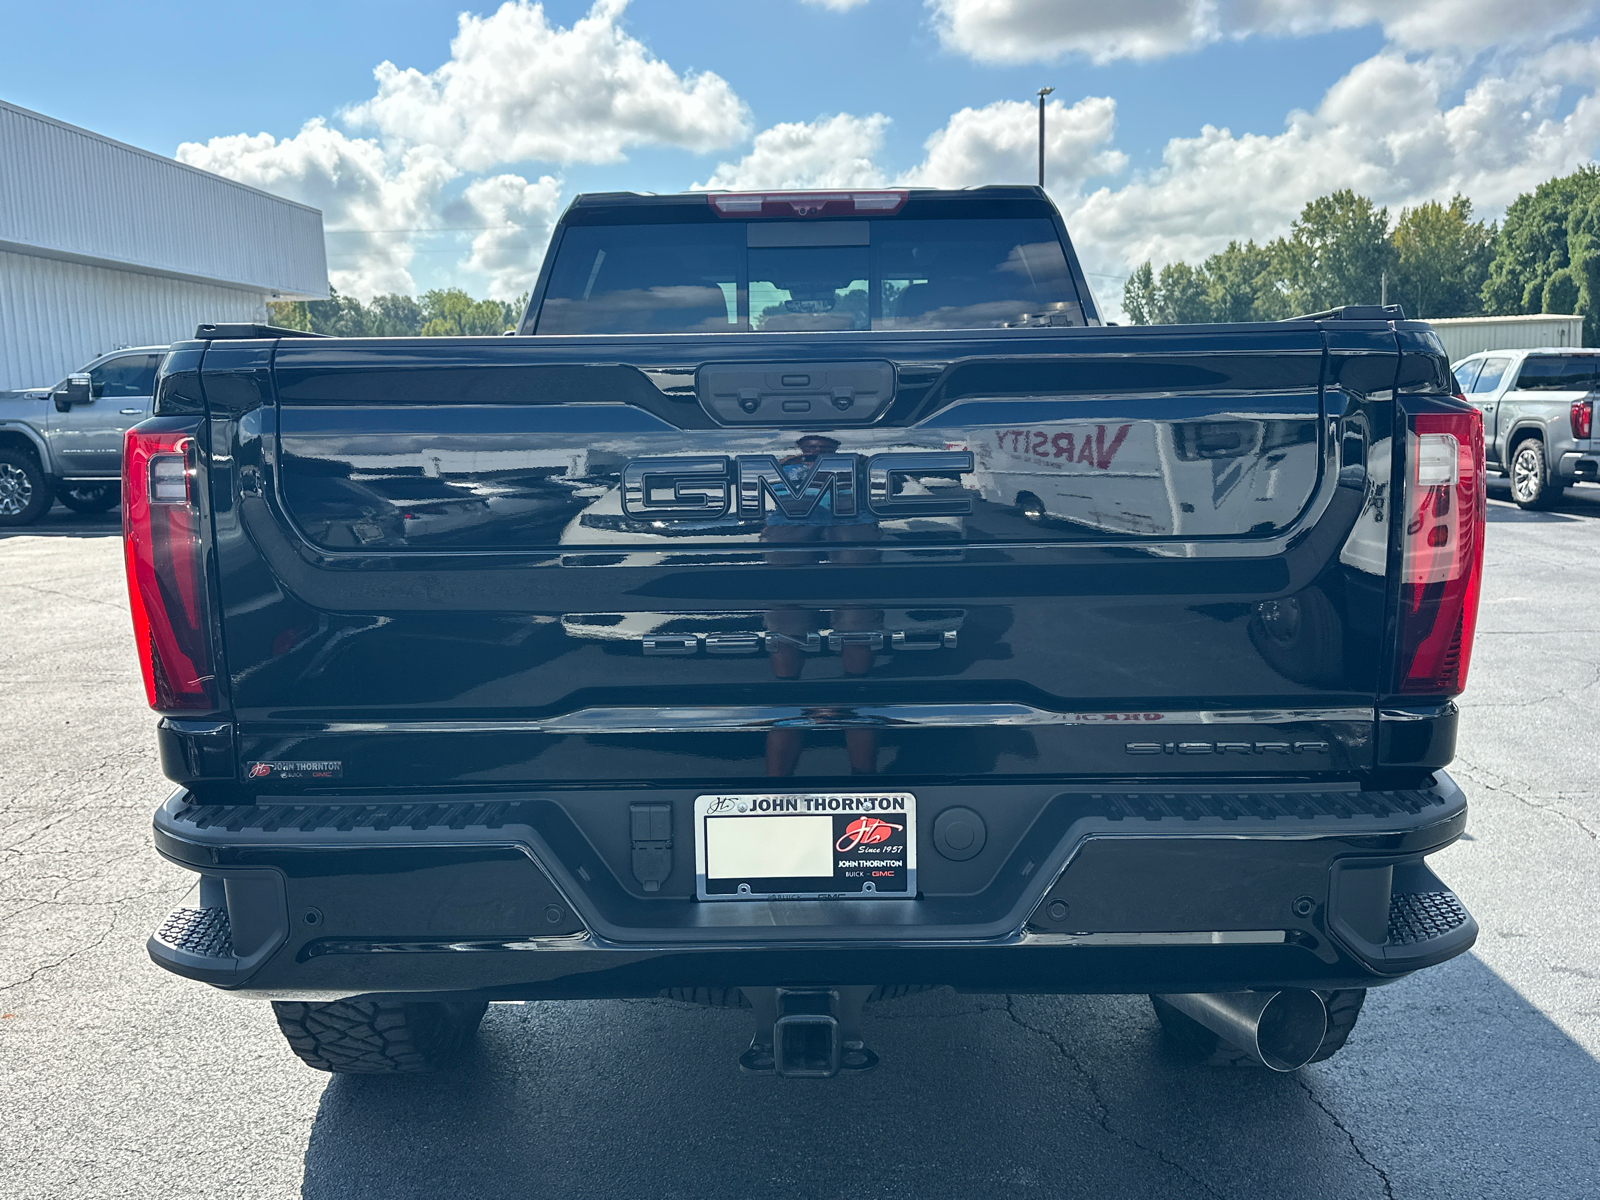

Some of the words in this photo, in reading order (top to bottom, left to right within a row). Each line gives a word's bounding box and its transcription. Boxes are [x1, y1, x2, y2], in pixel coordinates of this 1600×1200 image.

[620, 451, 975, 521] GMC
[1124, 740, 1330, 755] SIERRA
[273, 762, 295, 771] JOHN
[296, 762, 341, 771] THORNTON
[749, 798, 798, 812] JOHN
[803, 797, 905, 811] THORNTON
[857, 845, 881, 854] Since
[882, 845, 904, 854] 1957
[838, 860, 859, 868] JOHN
[859, 860, 903, 868] THORNTON
[817, 893, 847, 901] GMC
